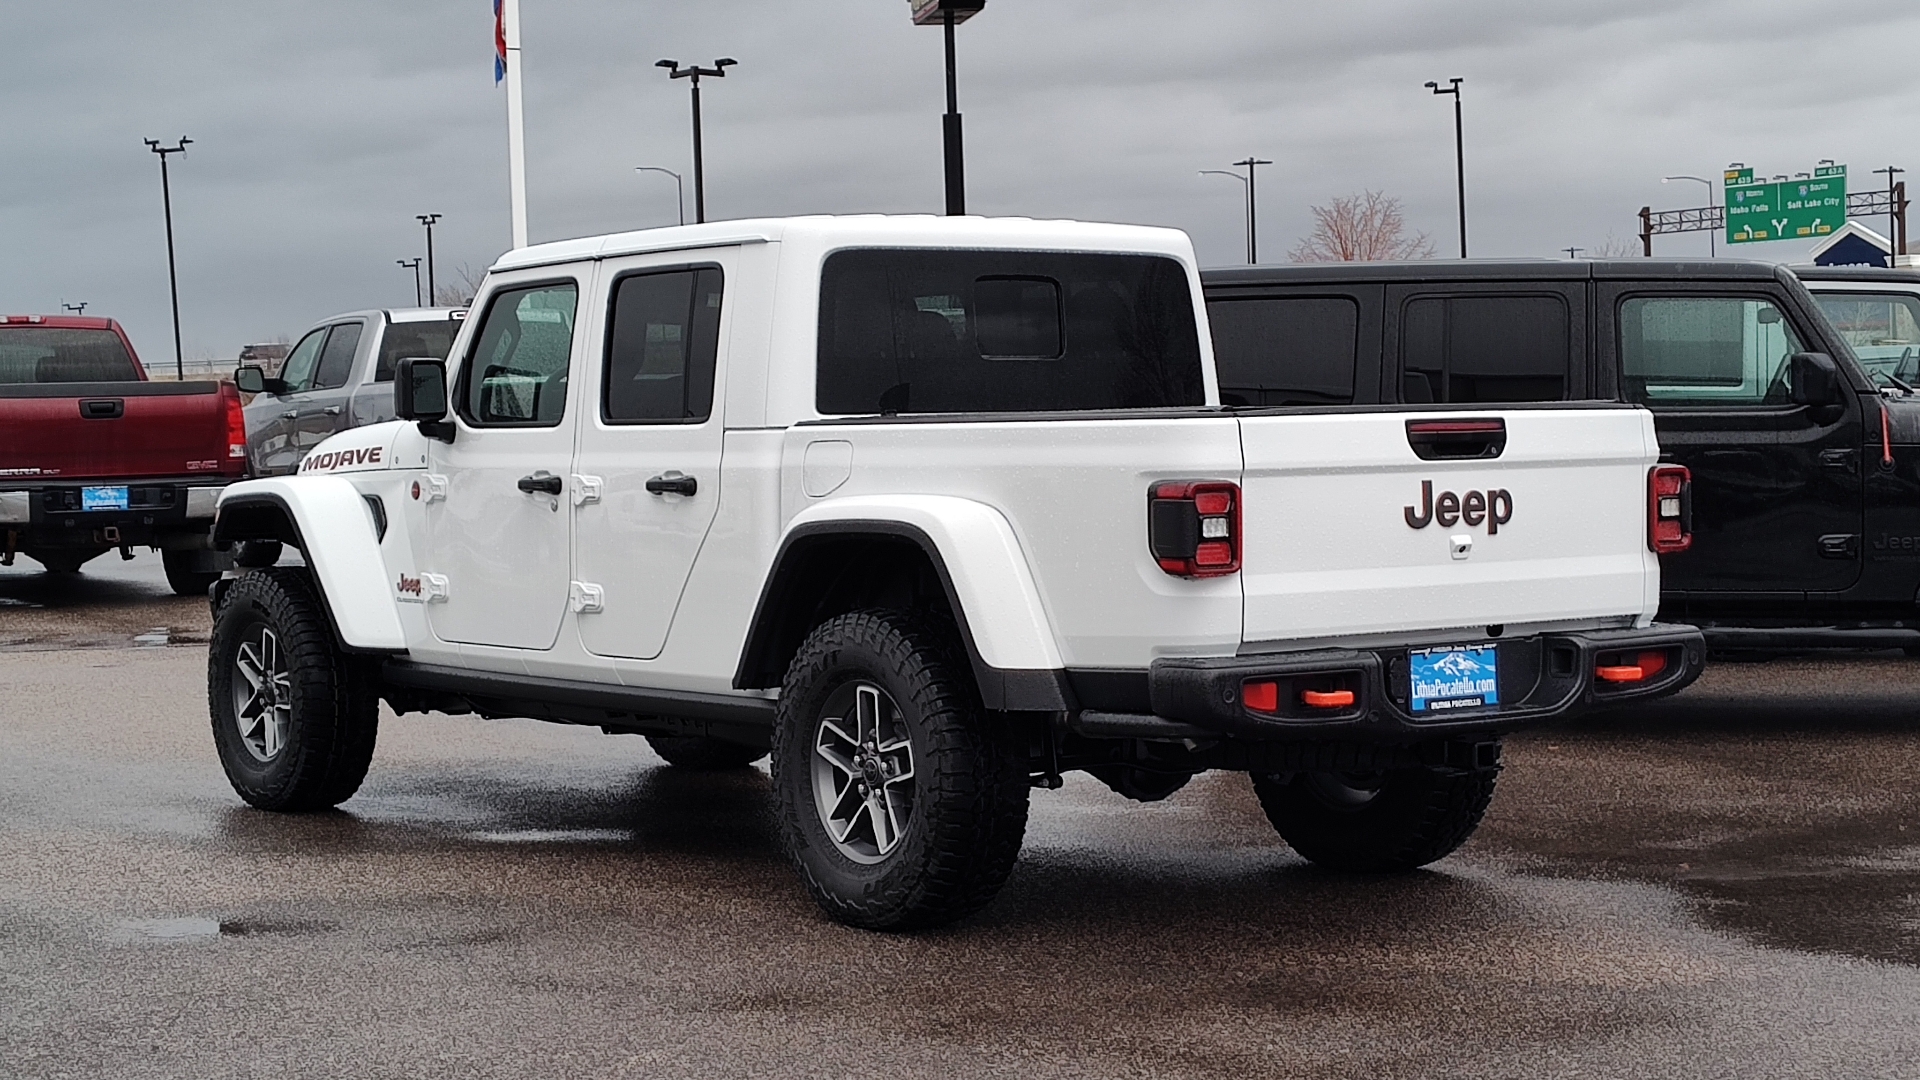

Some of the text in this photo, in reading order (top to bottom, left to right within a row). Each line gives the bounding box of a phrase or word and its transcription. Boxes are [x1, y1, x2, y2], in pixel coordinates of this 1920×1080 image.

[1730, 204, 1769, 214] Idaho Falls
[1787, 198, 1839, 209] Salt Lake City
[302, 446, 383, 472] MOJAVE
[1403, 479, 1513, 536] Jeep
[396, 572, 422, 597] Jeep
[1411, 676, 1496, 699] LithiaPocatello.com
